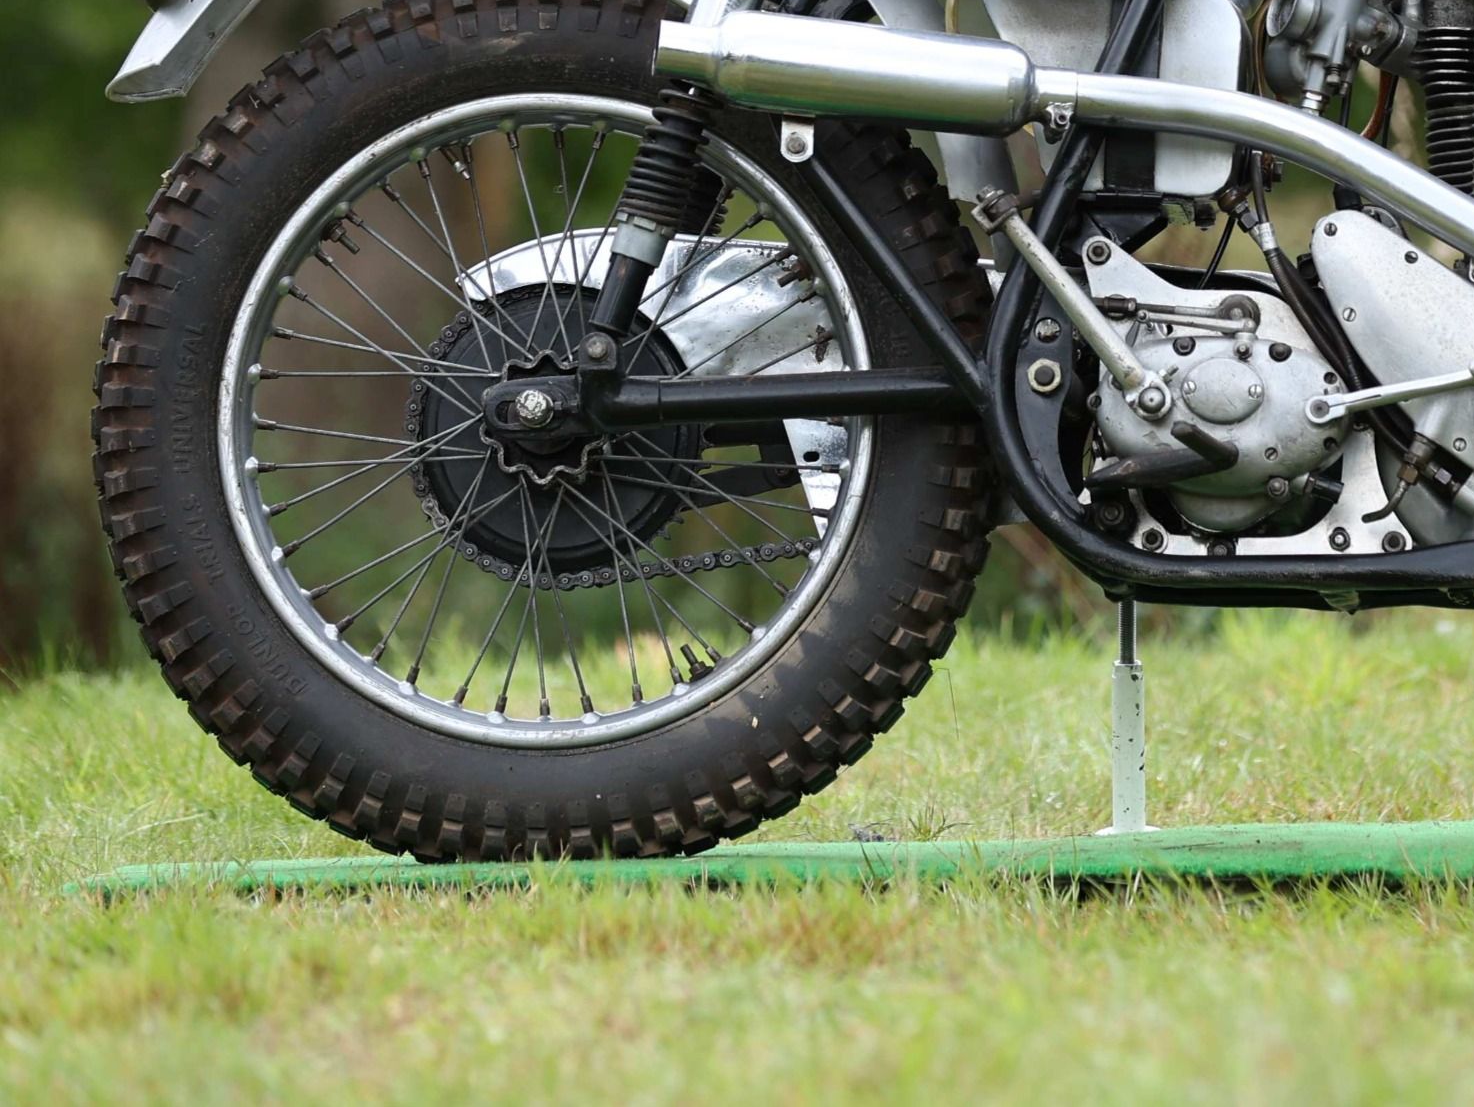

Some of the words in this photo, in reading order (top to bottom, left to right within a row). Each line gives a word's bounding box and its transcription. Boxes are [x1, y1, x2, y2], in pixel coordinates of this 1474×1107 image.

[172, 322, 206, 475] UNIVERSAL
[181, 493, 223, 584] TRIALS
[225, 603, 309, 695] DUNLOP
